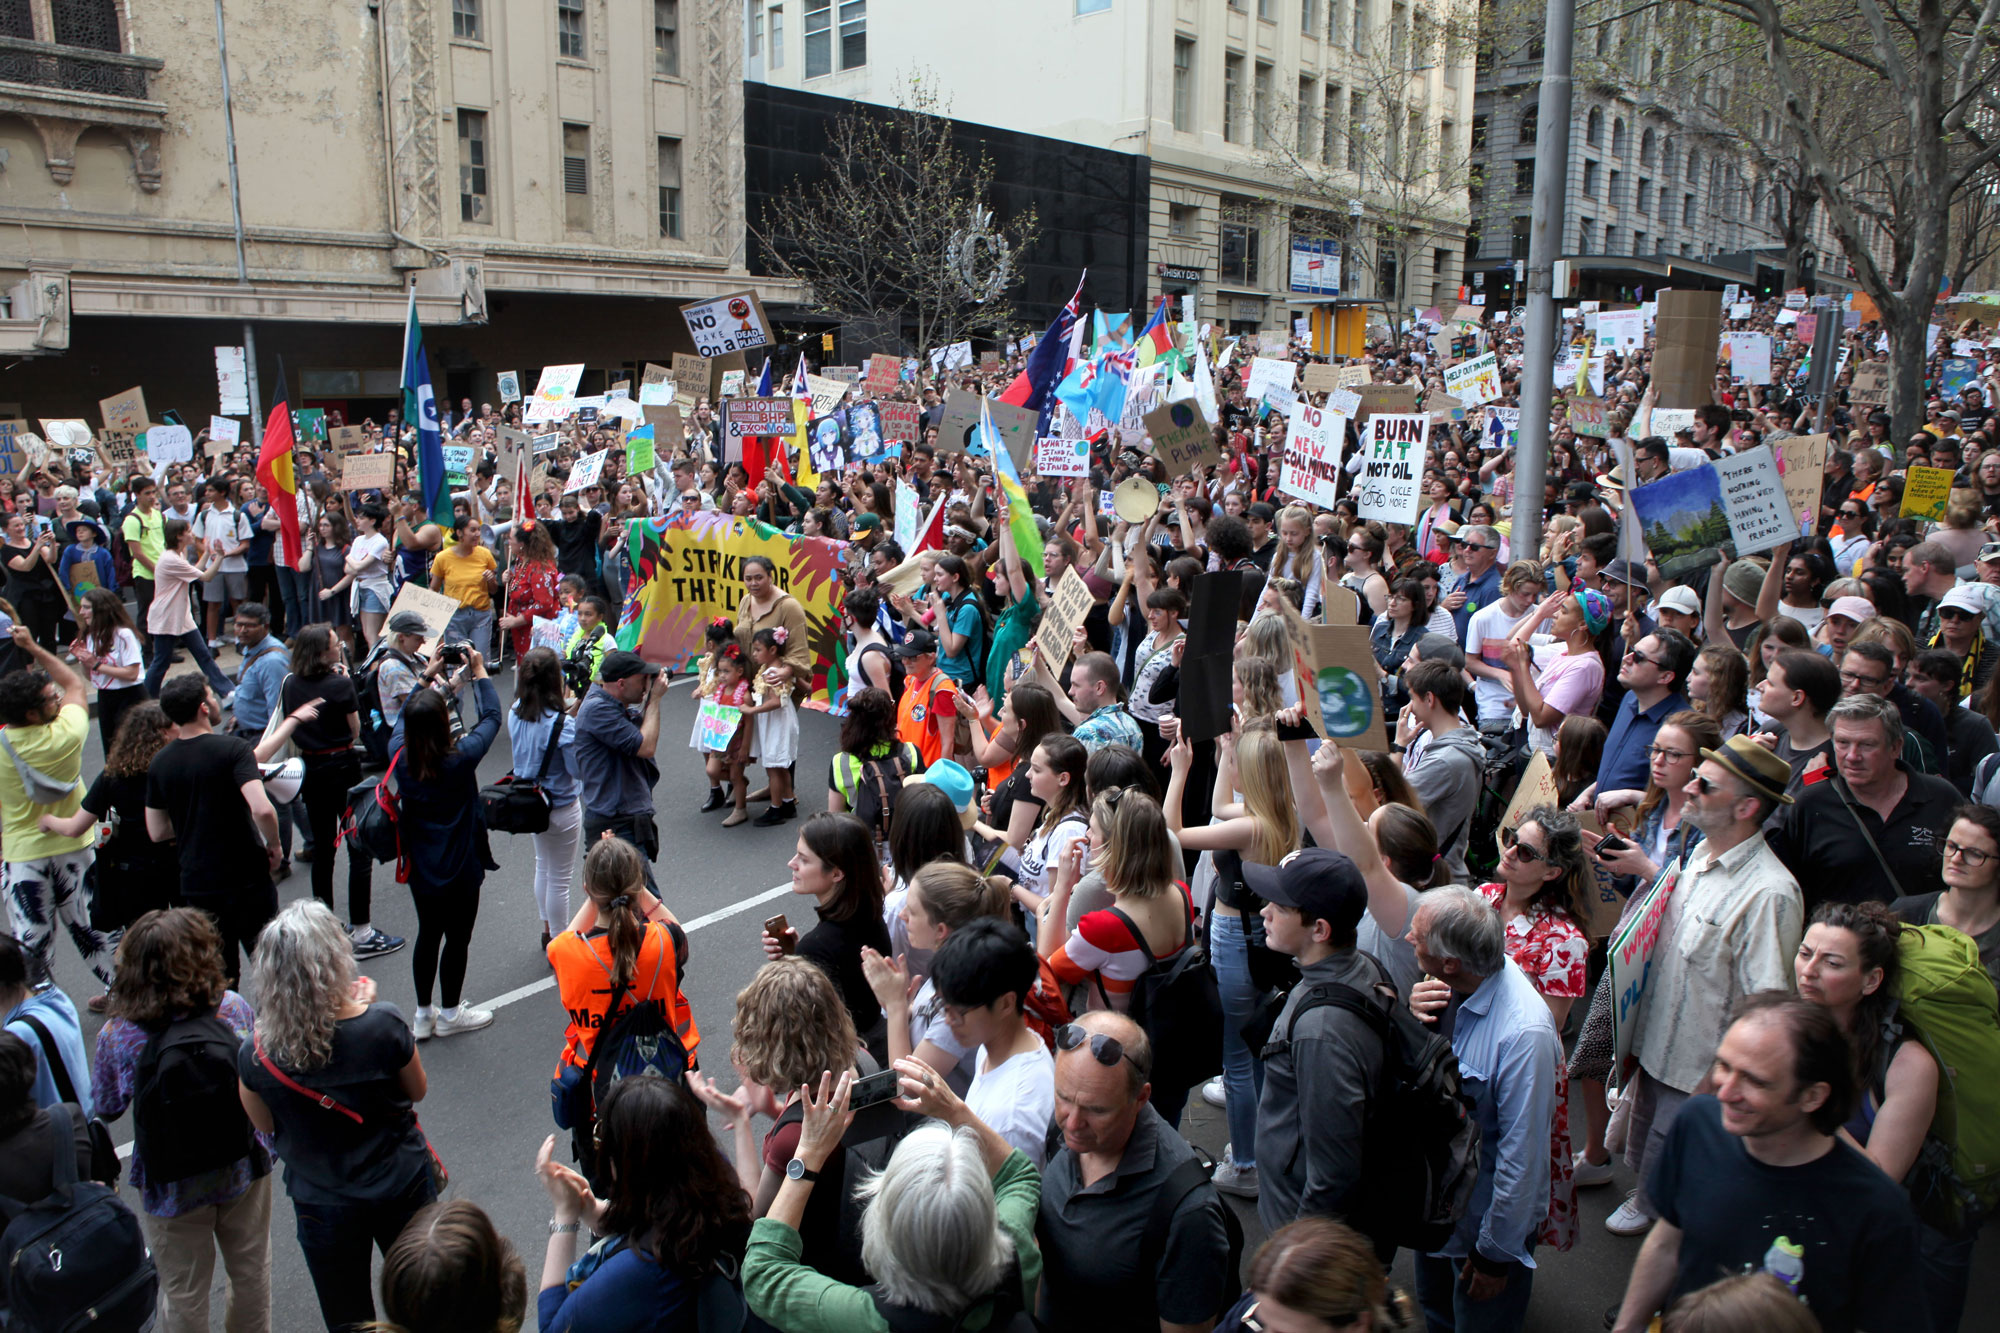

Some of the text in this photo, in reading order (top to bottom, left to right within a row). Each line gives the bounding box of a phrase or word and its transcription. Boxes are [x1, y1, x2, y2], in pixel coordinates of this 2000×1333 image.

[1186, 269, 1200, 281] DEN
[689, 315, 716, 332] NO
[695, 330, 725, 343] CAKE
[736, 329, 759, 339] DEAD
[739, 336, 767, 348] PLANET
[700, 339, 736, 357] On a
[1446, 369, 1462, 383] HELP
[745, 400, 774, 411] RIOT
[760, 411, 786, 423] BHP
[1302, 406, 1322, 428] NO
[1374, 419, 1424, 443] BURN
[104, 441, 132, 451] WITH
[1040, 440, 1073, 448] WHAT I
[1294, 436, 1325, 459] NEW
[1374, 440, 1411, 460] FAT
[112, 450, 136, 460] HER
[1039, 463, 1084, 472] STAND ON
[1283, 448, 1337, 484] COAL MINES
[1366, 462, 1413, 480] NOT OIL
[1758, 462, 1767, 470] IS
[1290, 470, 1318, 495] EVER.
[1390, 485, 1412, 497] CYCLE
[1728, 479, 1761, 494] NOTHING
[1389, 498, 1408, 509] MORE
[1734, 502, 1775, 520] HAVING A
[1736, 521, 1756, 533] TREE
[1773, 513, 1779, 521] A
[672, 578, 716, 603] THE
[1062, 573, 1091, 612] SCREW
[1059, 593, 1077, 623] YOUR
[1040, 625, 1066, 666] AGENDA
[1623, 873, 1675, 965] WHERE'S
